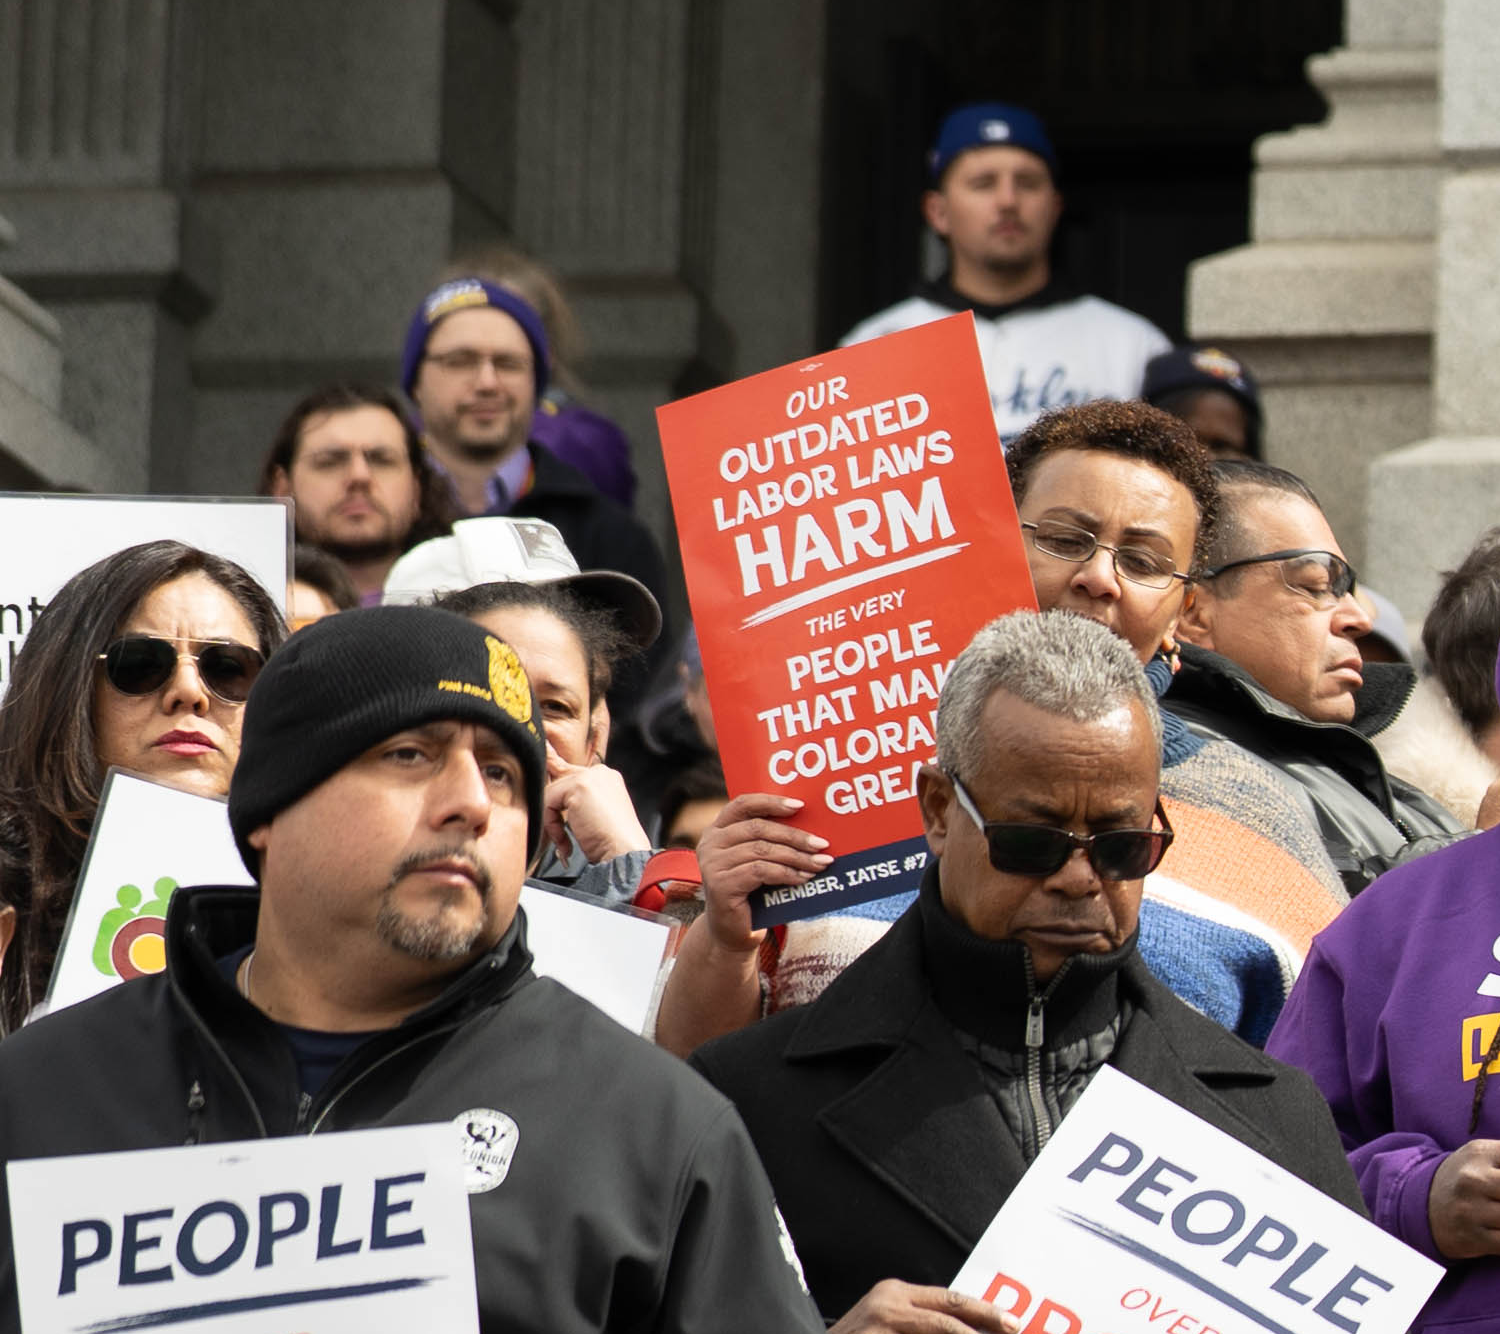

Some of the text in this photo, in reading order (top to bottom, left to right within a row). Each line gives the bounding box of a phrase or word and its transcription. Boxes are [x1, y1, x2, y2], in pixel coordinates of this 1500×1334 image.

[785, 375, 848, 419] OUR
[719, 392, 930, 483] OUTDATED
[713, 429, 955, 531] LABOR LAWS
[734, 476, 955, 596] HARM
[805, 588, 906, 637] THE VERY
[786, 619, 939, 691] PEOPLE
[757, 683, 860, 744] THAT
[768, 713, 940, 785] COLORA
[824, 762, 936, 817] GREA
[763, 851, 928, 907] MEMBER, IATSE #7
[58, 1171, 427, 1298] PEOPLE
